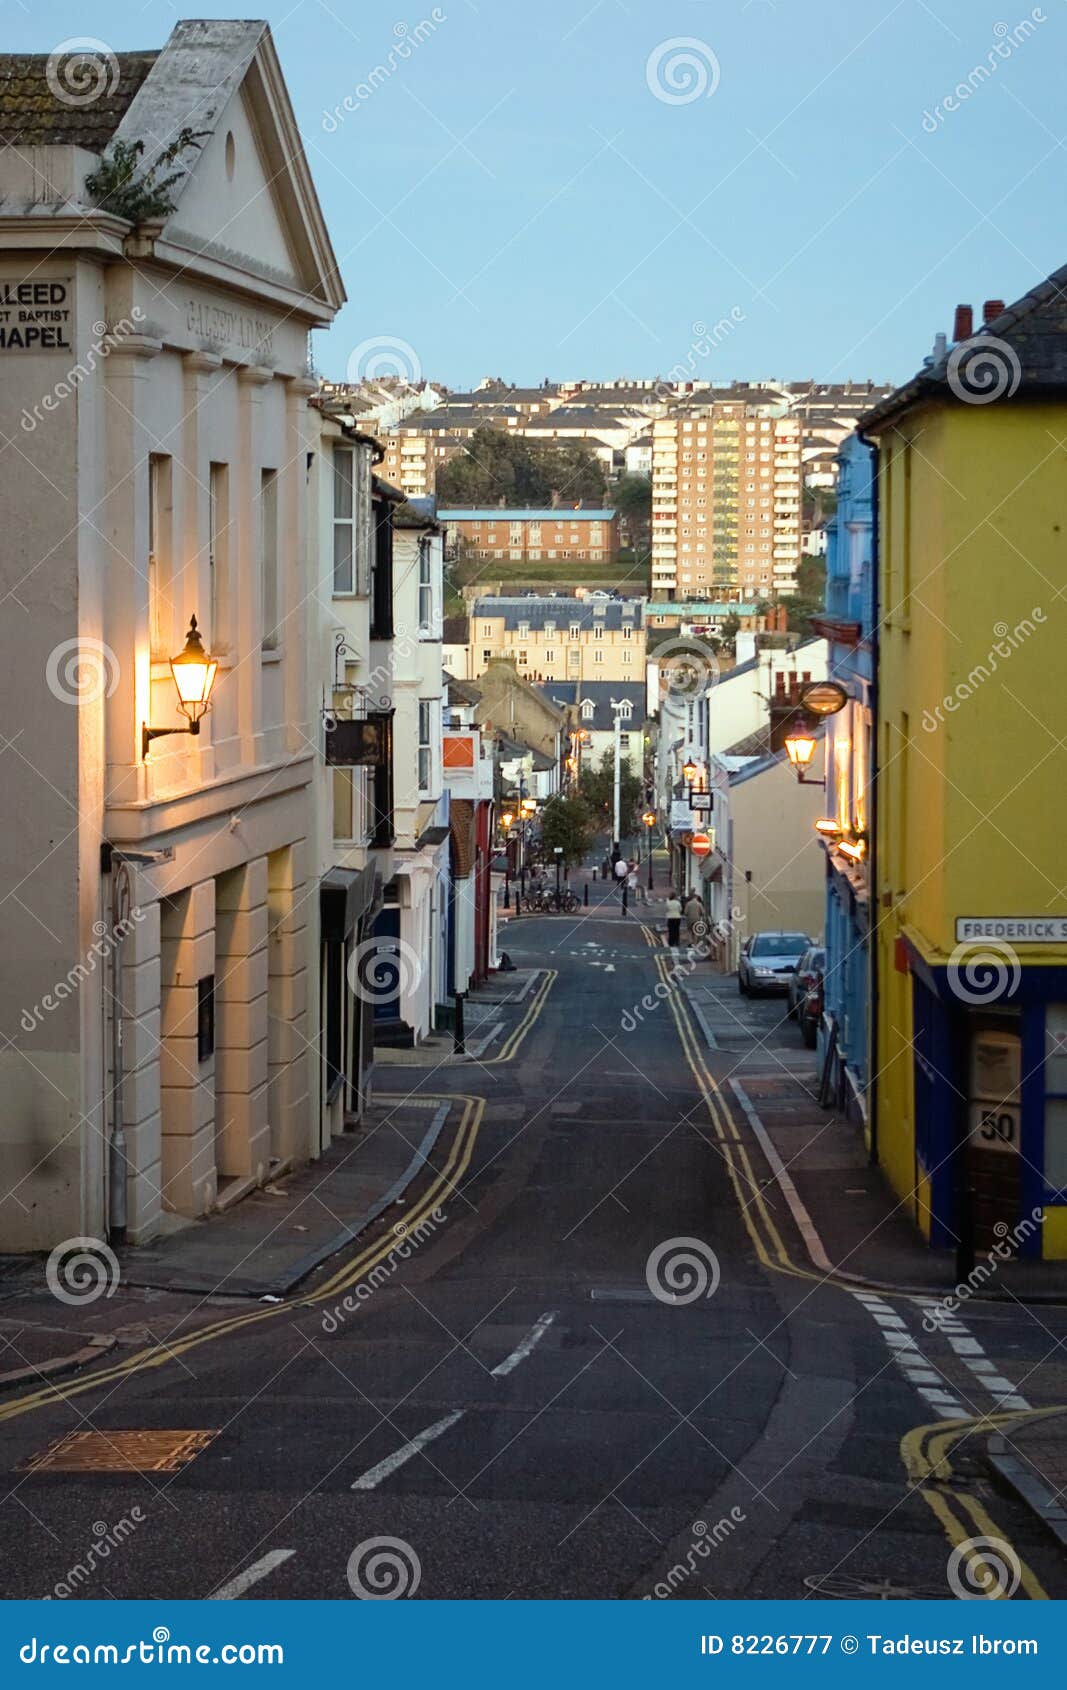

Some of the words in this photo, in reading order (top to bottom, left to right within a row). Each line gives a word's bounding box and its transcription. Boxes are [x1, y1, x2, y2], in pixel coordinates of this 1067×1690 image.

[0, 284, 66, 305] LEED
[0, 310, 11, 322] T
[19, 310, 69, 322] BAPTIST
[963, 923, 1054, 936] FREDERICK
[980, 1110, 1014, 1143] 50
